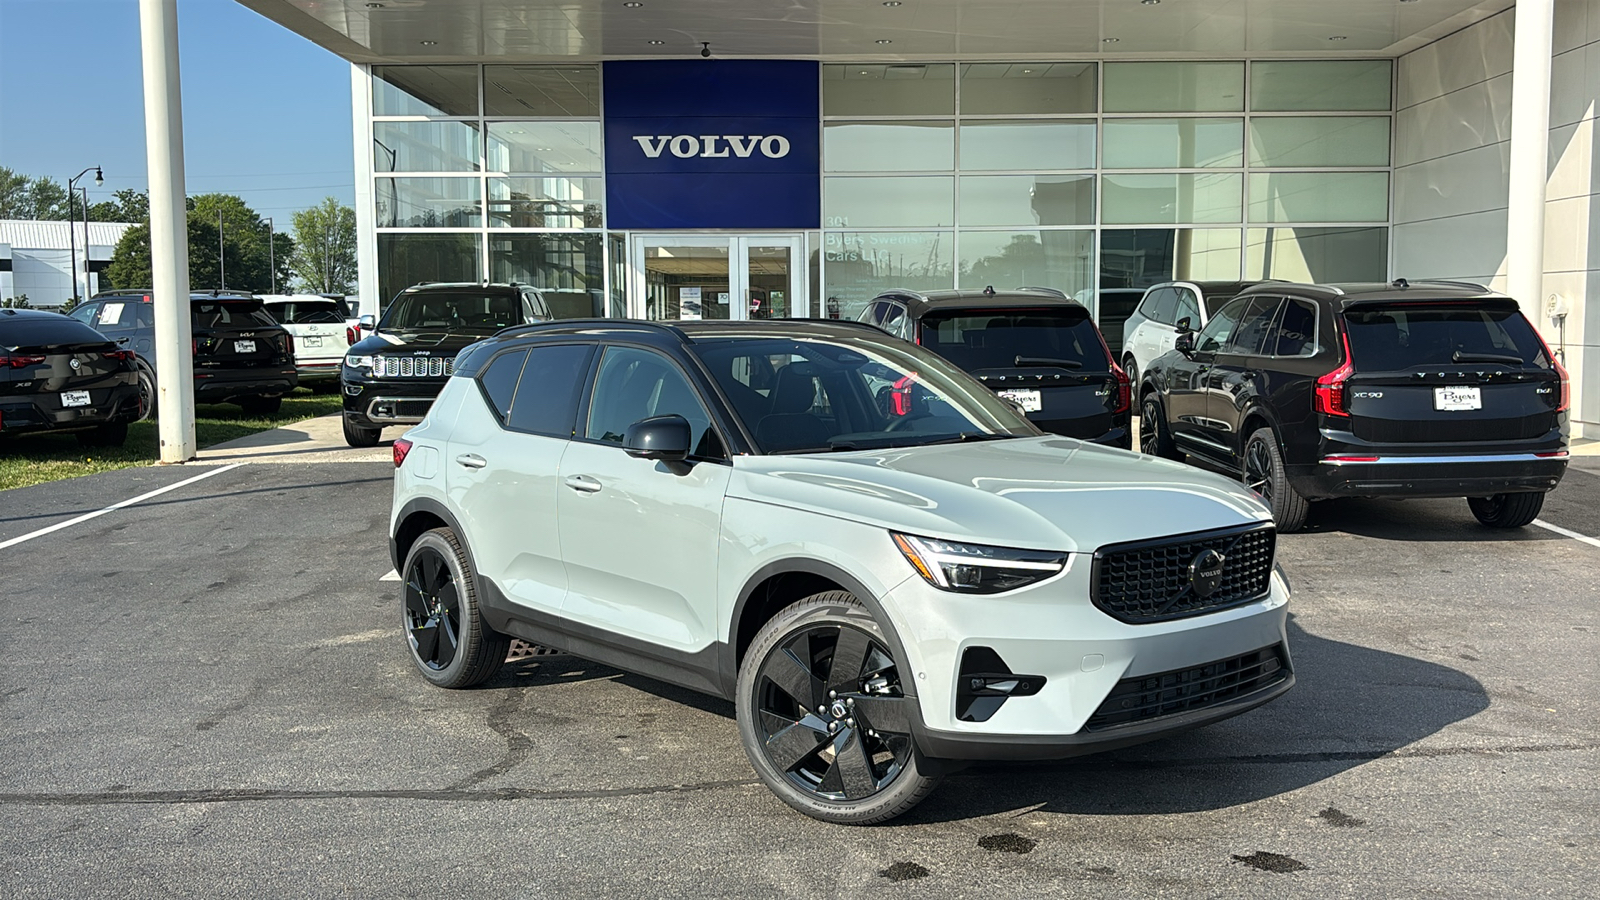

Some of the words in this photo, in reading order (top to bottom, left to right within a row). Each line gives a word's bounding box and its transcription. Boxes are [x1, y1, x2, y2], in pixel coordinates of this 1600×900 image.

[633, 135, 790, 158] VOLVO
[826, 217, 849, 227] 301
[826, 234, 864, 248] Byers
[826, 250, 858, 262] Cars
[862, 250, 890, 262] LLC
[1438, 390, 1476, 404] Byers
[1200, 569, 1221, 578] VOLVO
